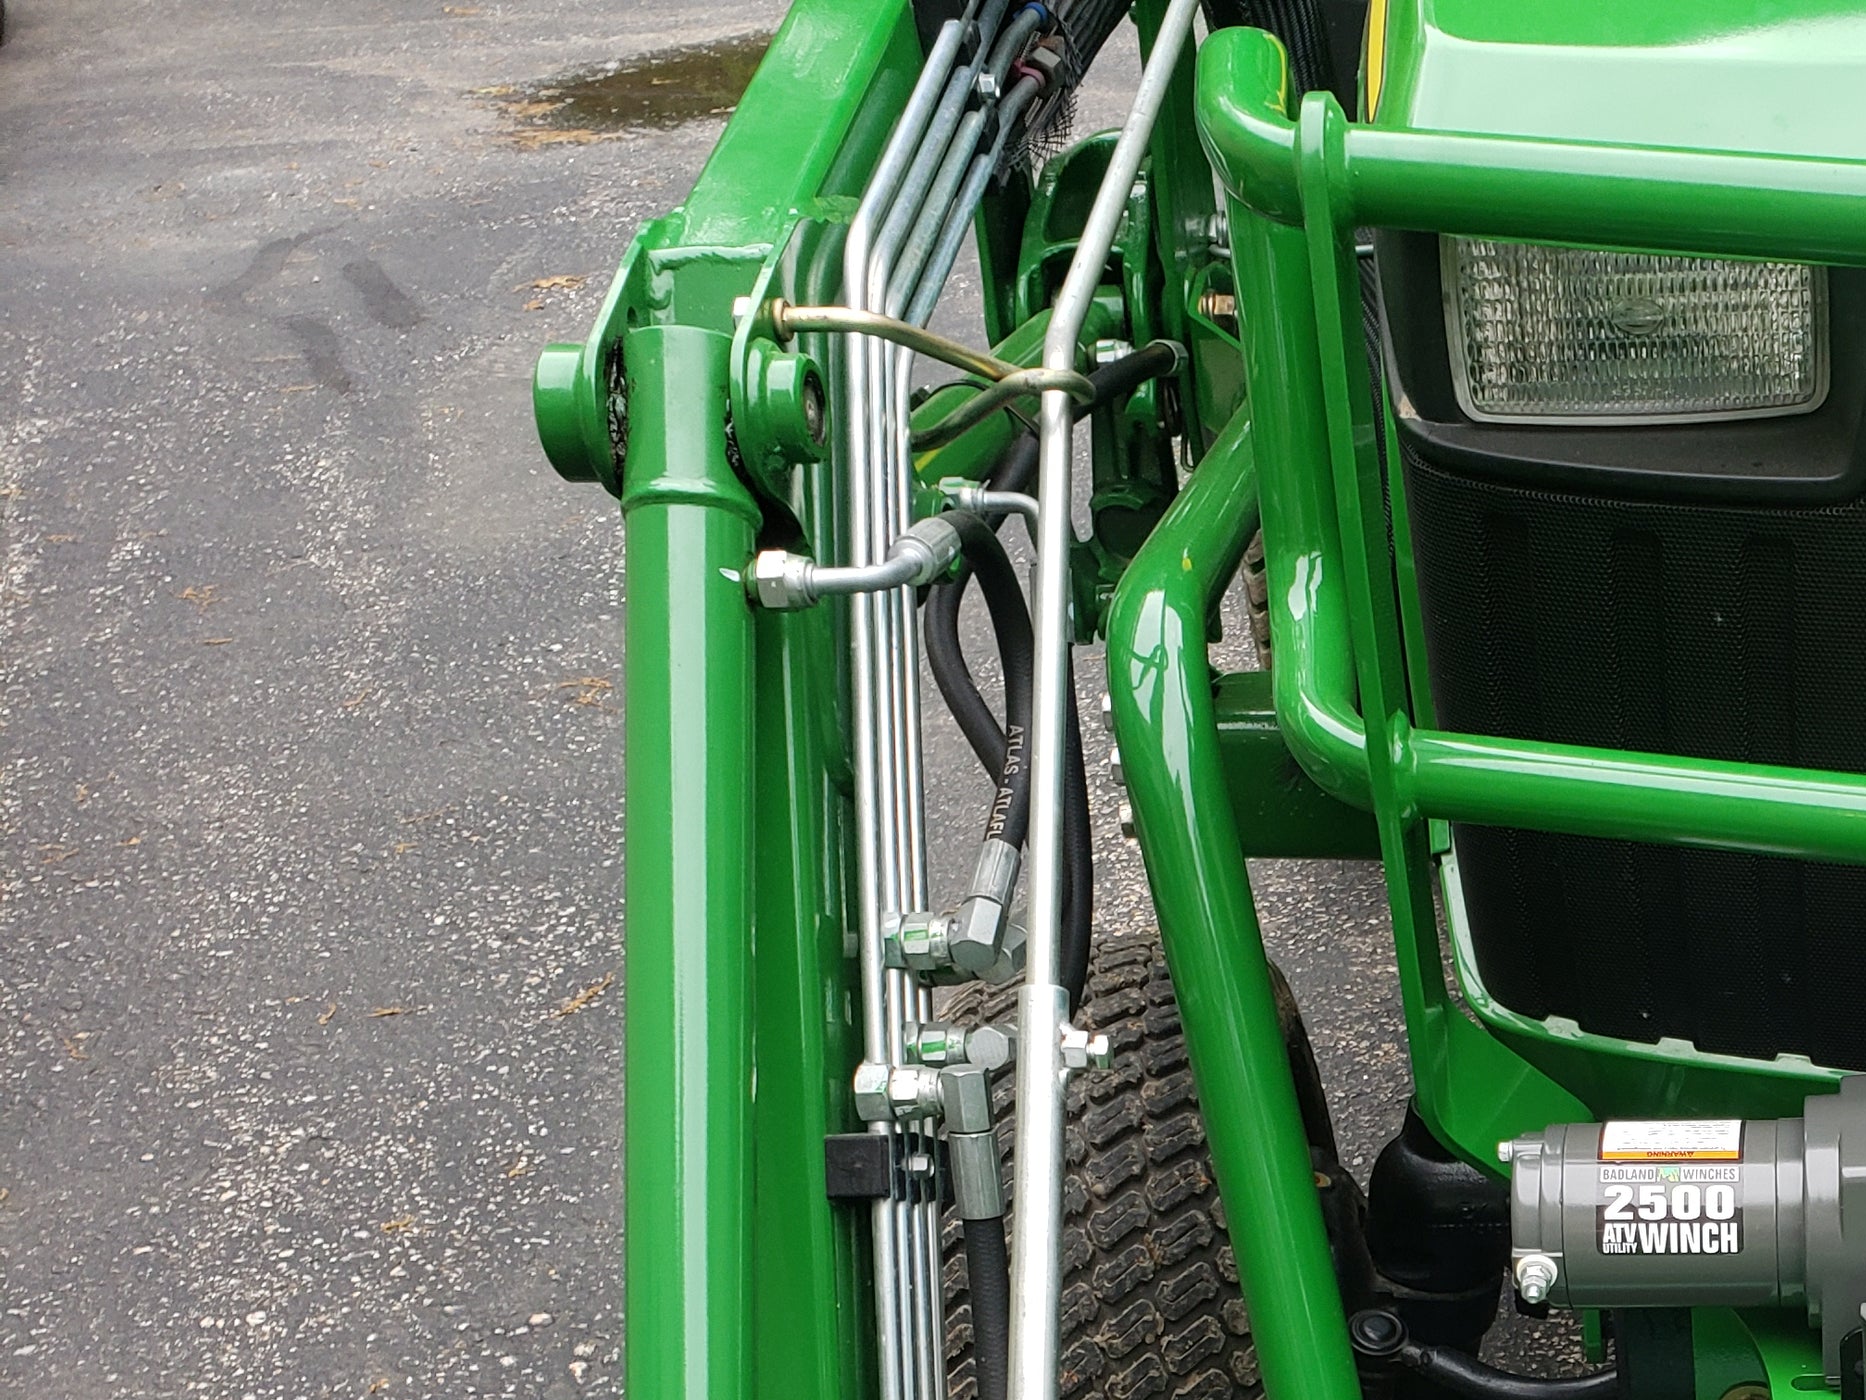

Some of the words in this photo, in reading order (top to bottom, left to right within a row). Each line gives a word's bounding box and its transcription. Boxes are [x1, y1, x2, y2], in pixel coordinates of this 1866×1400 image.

[1004, 725, 1025, 775] ATLAS
[1603, 1168, 1655, 1181] BADLAND
[1682, 1168, 1736, 1180] WINCHES
[1603, 1184, 1735, 1221] 2500
[1602, 1222, 1638, 1243] ATV
[1638, 1222, 1739, 1254] WINCH
[1602, 1242, 1638, 1254] UTILITY
